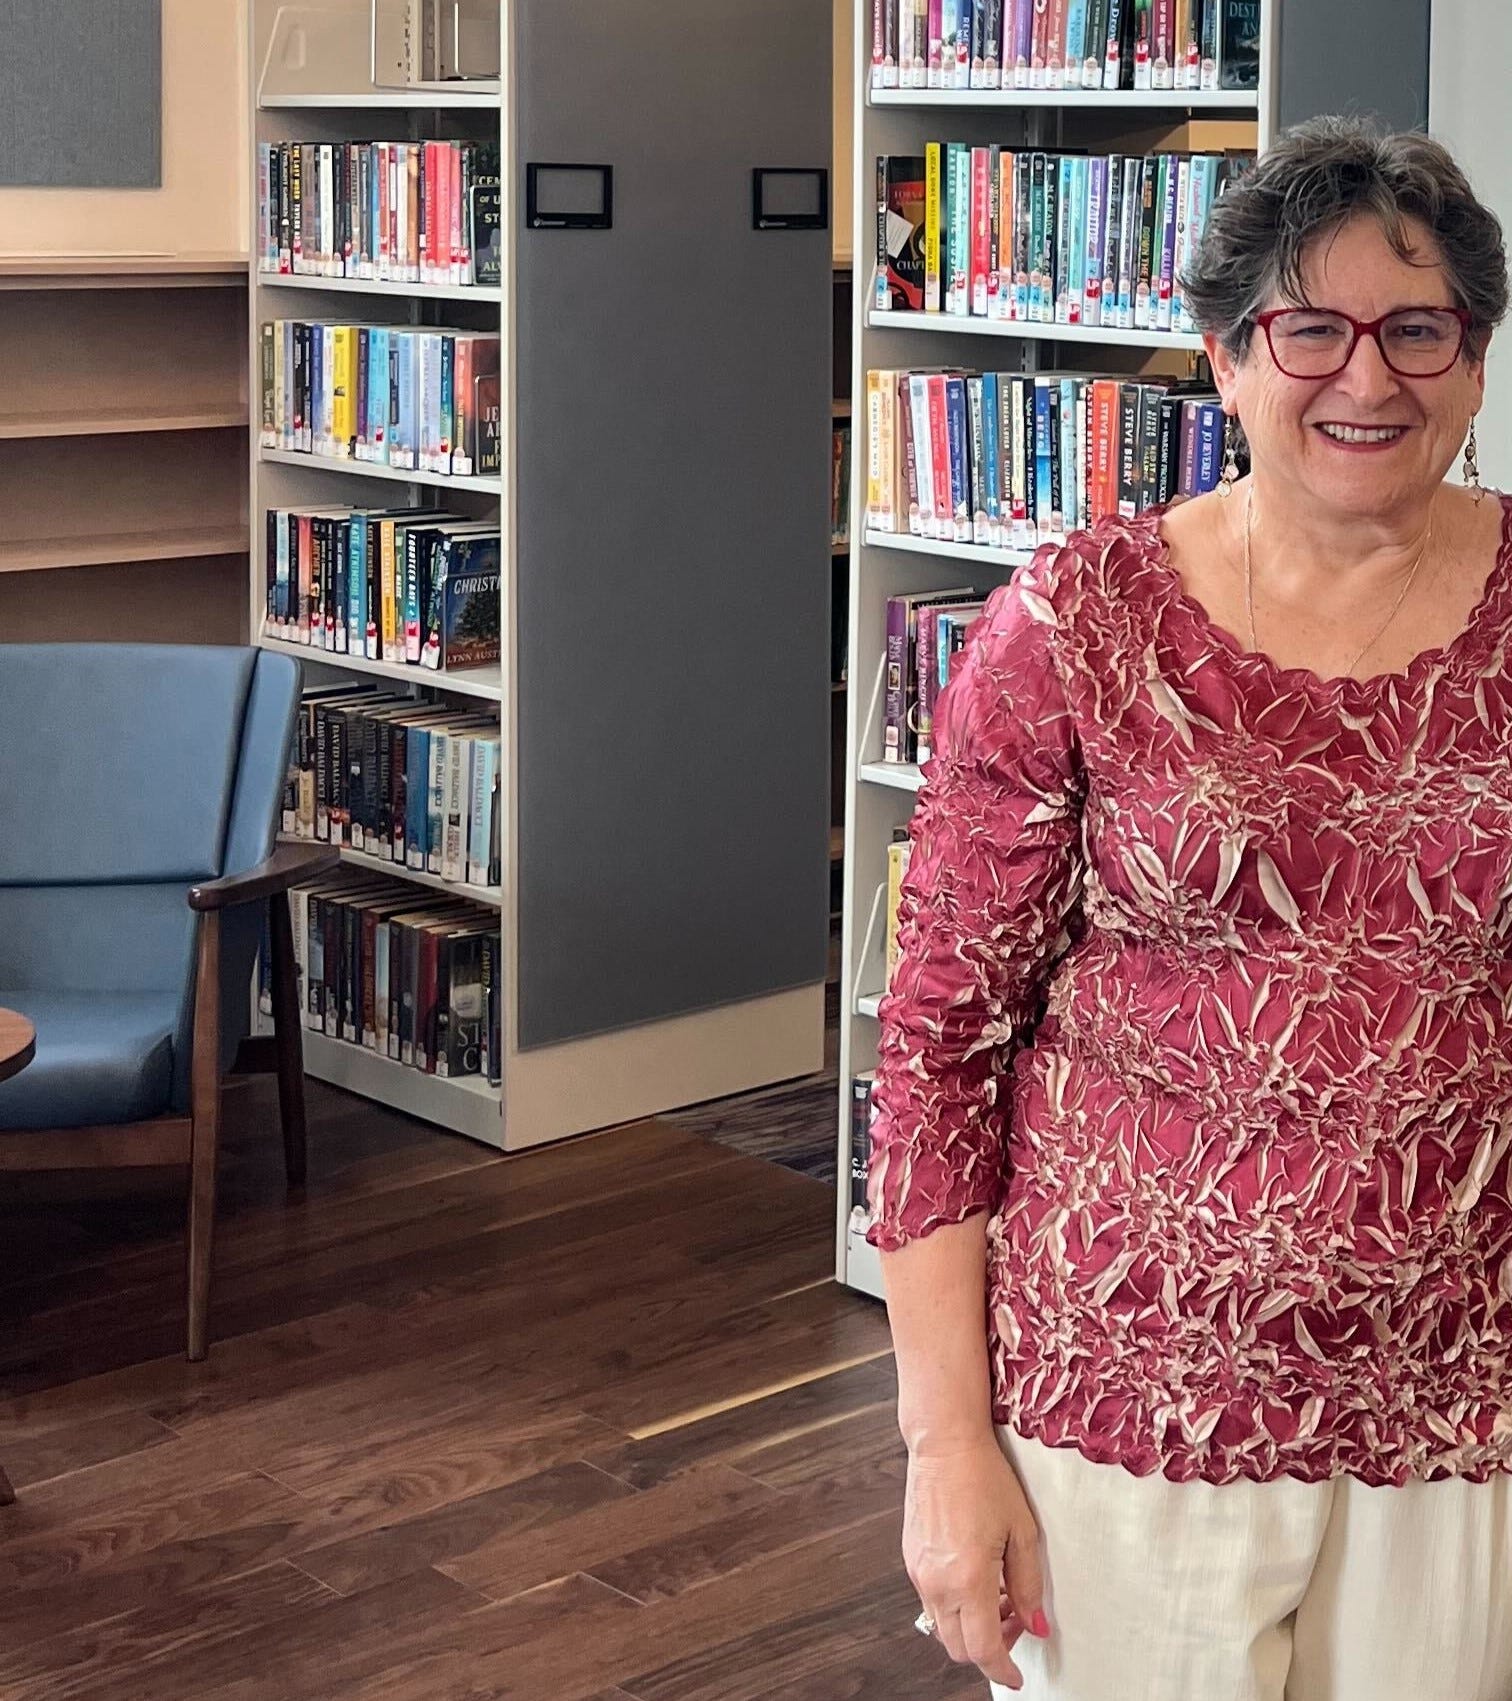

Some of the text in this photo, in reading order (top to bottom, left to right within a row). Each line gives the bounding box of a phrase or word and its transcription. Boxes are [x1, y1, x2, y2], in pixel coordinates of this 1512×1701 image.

[1140, 258, 1148, 277] THE
[1026, 416, 1032, 425] of
[1098, 402, 1108, 472] STEVE BERRY
[1122, 407, 1133, 485] STEVE BERRY
[1185, 426, 1194, 490] WENDELL BERRY
[1201, 431, 1212, 482] JO BEVERLEY
[908, 468, 917, 498] THIEVES
[312, 539, 320, 576] ARCHER
[351, 523, 359, 596] KATE ATKINSON
[408, 534, 416, 607] FOURTEEN DAYS
[446, 650, 472, 665] LYNN
[317, 721, 326, 799] DAVID BALDACCI
[332, 725, 341, 758] DAVID
[475, 746, 485, 777] DAVID
